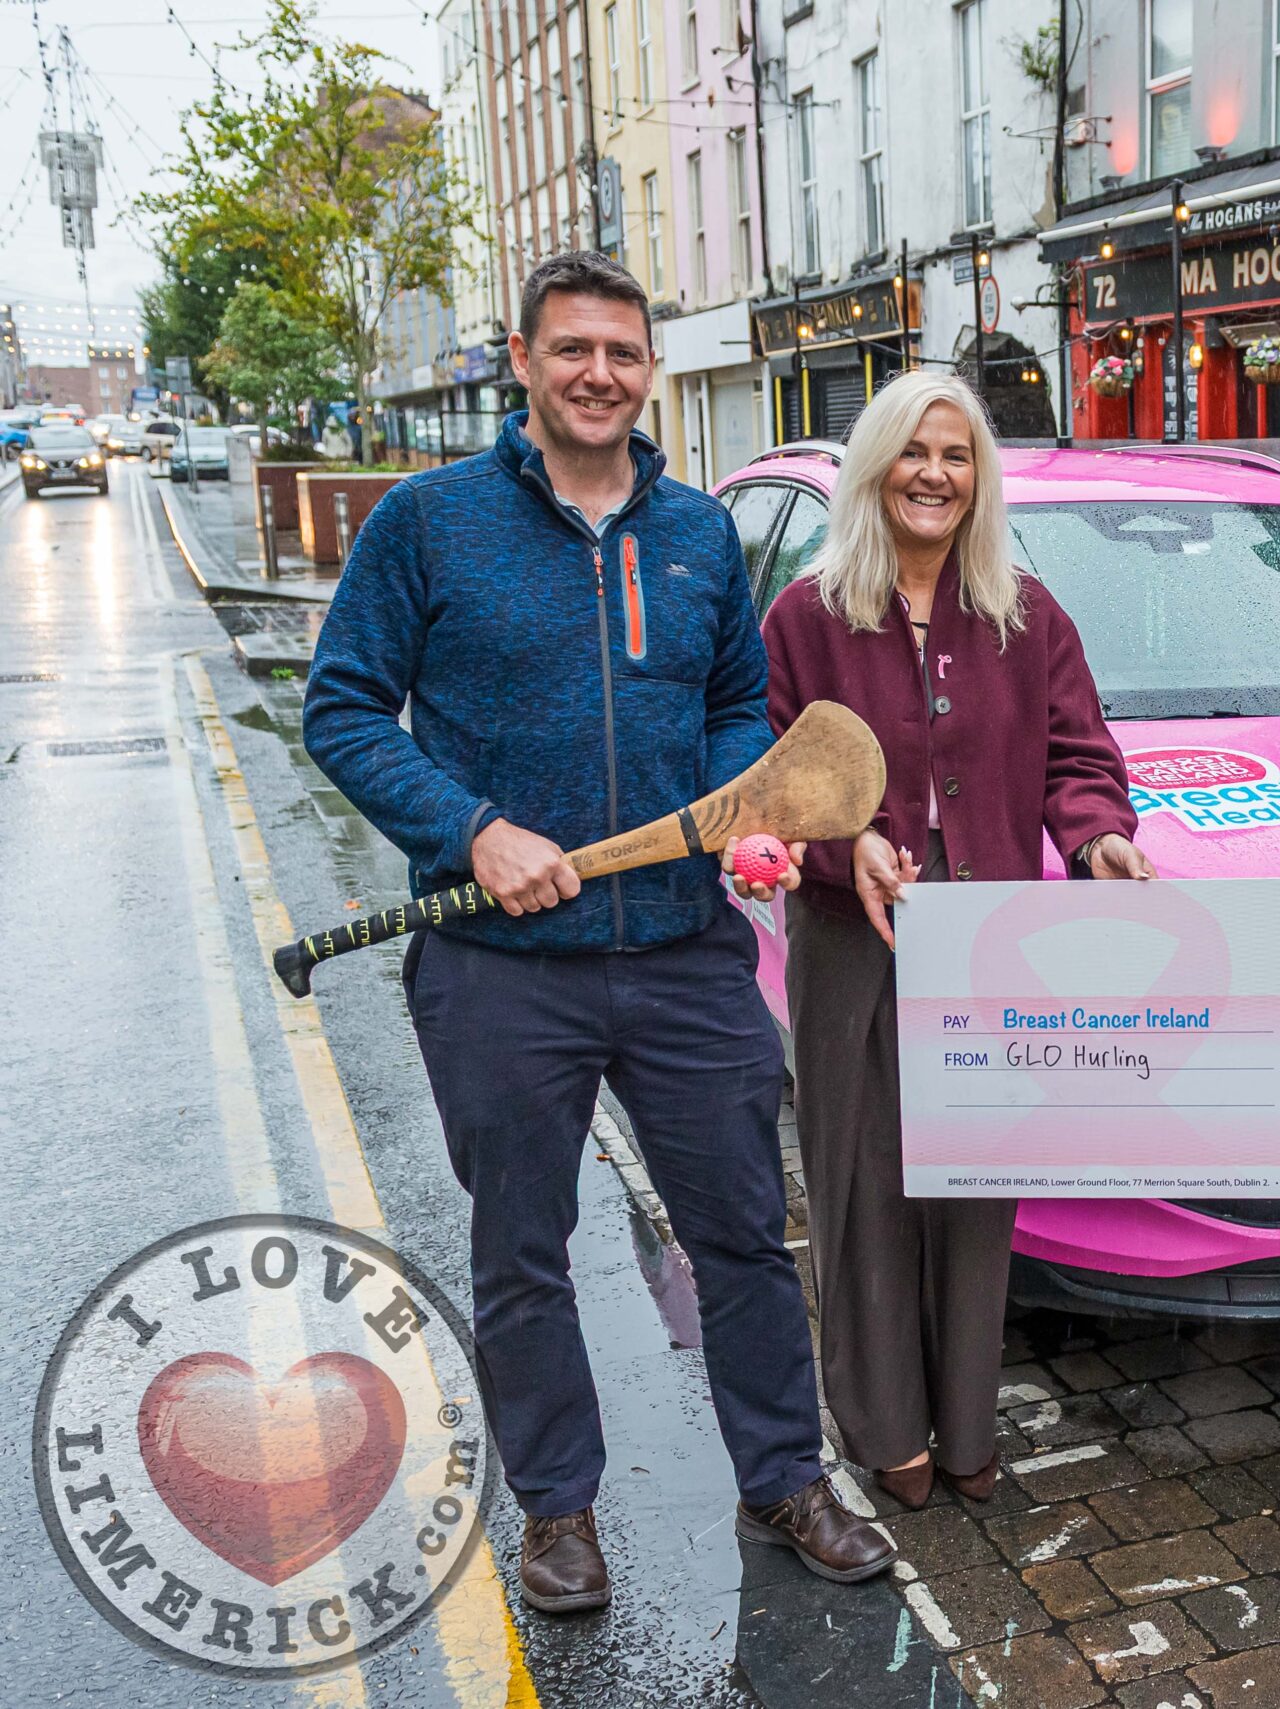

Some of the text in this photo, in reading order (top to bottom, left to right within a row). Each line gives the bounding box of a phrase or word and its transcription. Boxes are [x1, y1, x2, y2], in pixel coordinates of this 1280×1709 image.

[1205, 200, 1263, 230] HOGANS
[1180, 257, 1218, 297] MA
[1093, 275, 1117, 309] 72
[1131, 760, 1238, 777] CANCER
[1139, 767, 1250, 783] IRELAND
[601, 836, 659, 859] TORPEY
[943, 1015, 970, 1029] PAY
[1003, 1007, 1209, 1029] Breast Cancer Ireland
[944, 1053, 989, 1067] FROM
[1006, 1042, 1150, 1080] GLO Hurling
[948, 1177, 977, 1187] BREAST
[979, 1177, 1012, 1187] CANCER
[1013, 1177, 1050, 1189] IRELAND,
[1051, 1177, 1075, 1187] Lower
[1077, 1177, 1107, 1187] Ground
[1108, 1177, 1131, 1189] Floor,
[1132, 1177, 1142, 1187] 77
[1144, 1177, 1175, 1187] Merrion
[1177, 1177, 1205, 1189] Square
[1206, 1177, 1232, 1189] South,
[1234, 1177, 1261, 1187] Dublin
